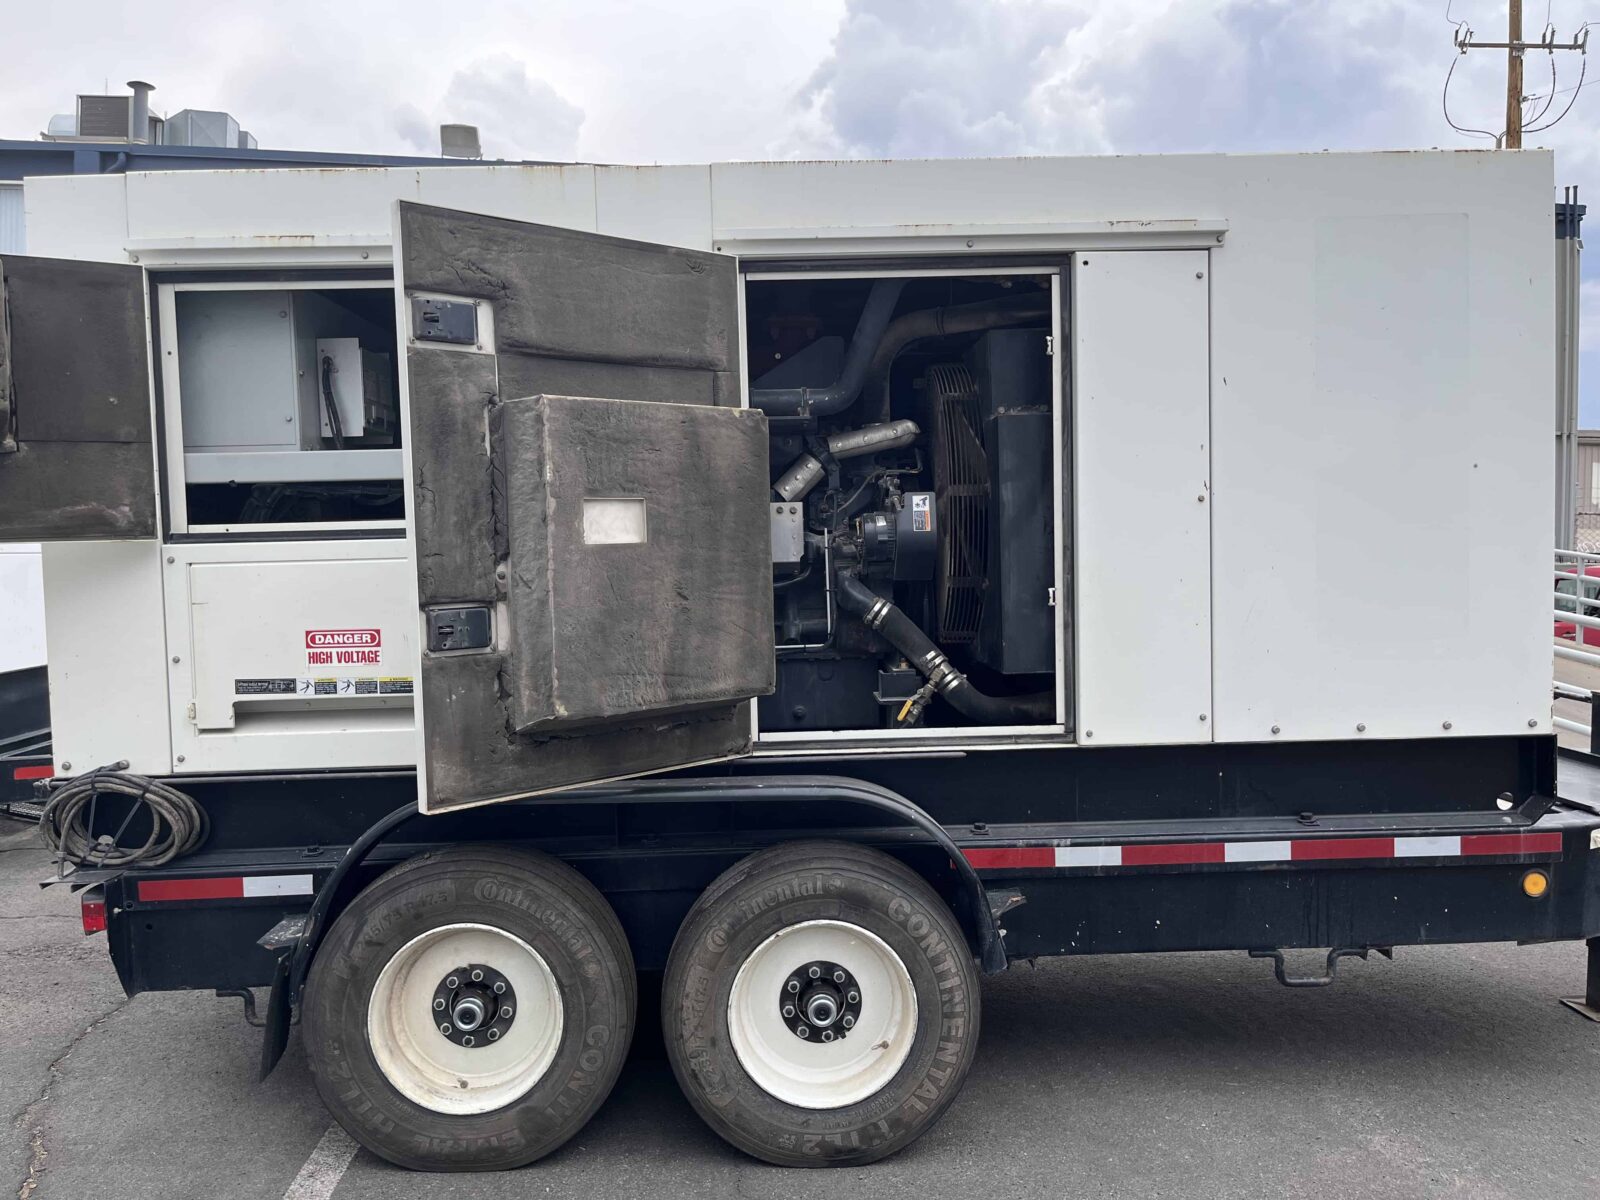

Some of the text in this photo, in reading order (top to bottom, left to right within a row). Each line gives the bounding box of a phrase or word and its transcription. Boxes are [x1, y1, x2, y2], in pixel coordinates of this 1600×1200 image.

[308, 650, 380, 665] HIGH VOLTAGE
[315, 633, 371, 644] DANGER
[473, 876, 593, 960] Continental
[705, 873, 824, 953] Coninental
[887, 897, 965, 1117] CONTINENTAL
[414, 1025, 610, 1154] CONTIEAL
